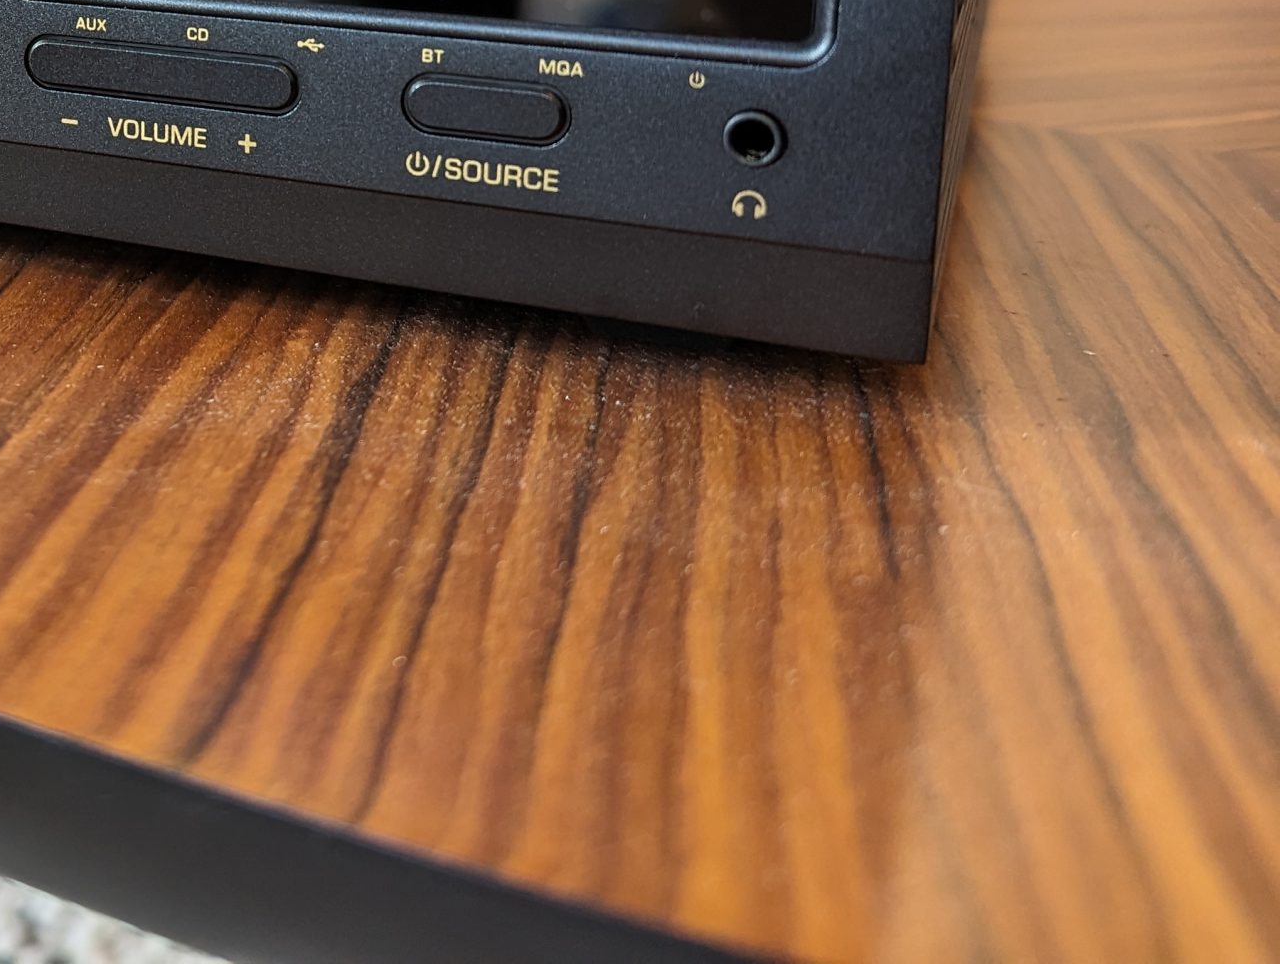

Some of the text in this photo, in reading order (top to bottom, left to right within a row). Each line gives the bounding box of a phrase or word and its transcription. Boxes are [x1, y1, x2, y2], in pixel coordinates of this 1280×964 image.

[75, 16, 107, 33] AUX
[186, 27, 210, 43] CD
[421, 48, 444, 64] BT
[538, 58, 583, 77] MQA
[107, 117, 207, 148] VOLUME
